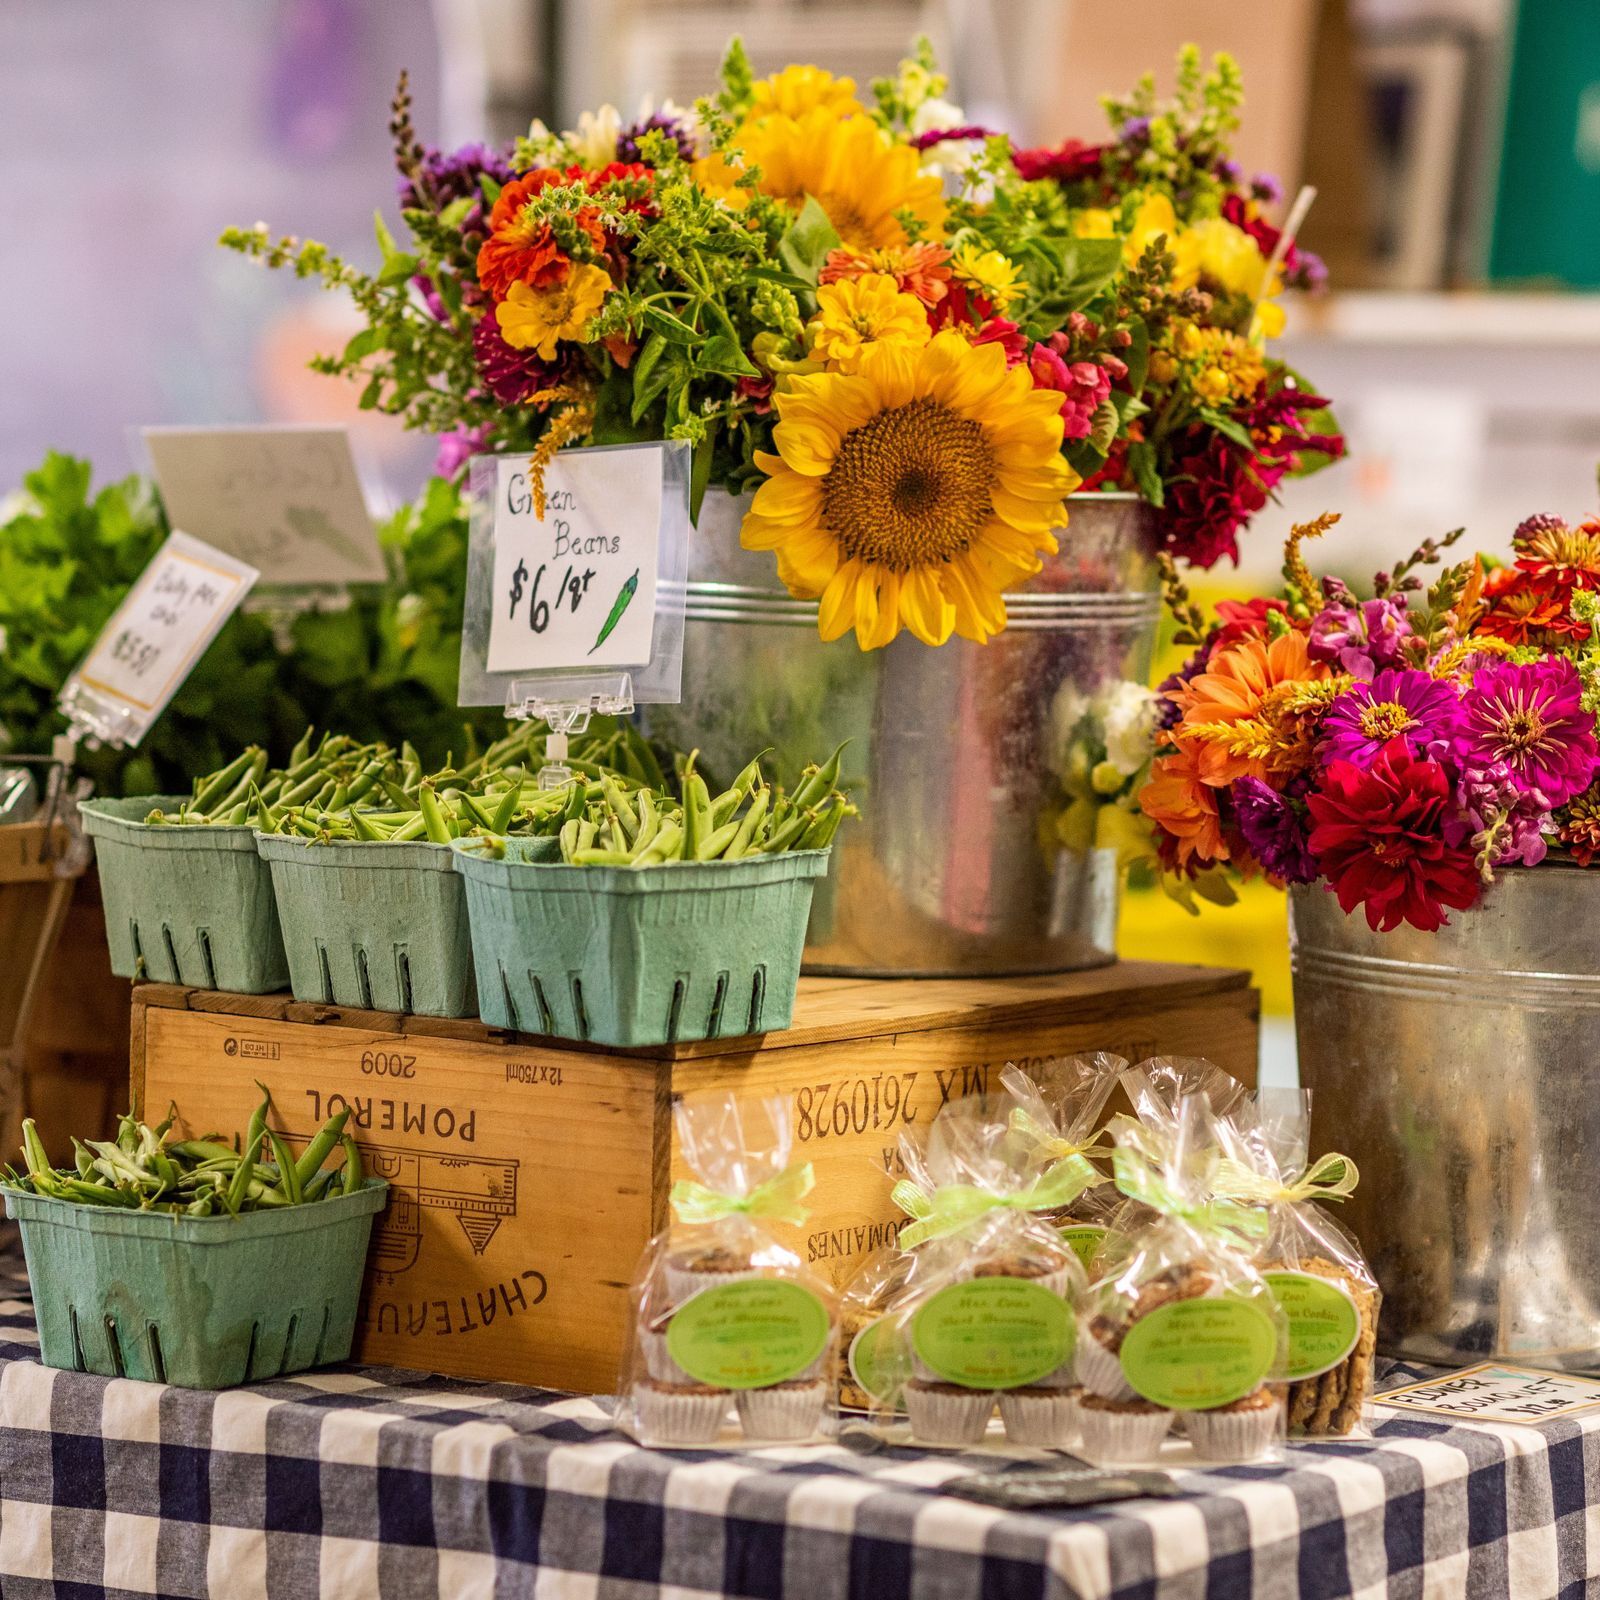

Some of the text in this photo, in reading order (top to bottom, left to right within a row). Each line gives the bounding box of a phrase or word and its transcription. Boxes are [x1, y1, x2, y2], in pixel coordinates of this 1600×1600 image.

[508, 473, 577, 515] Gren
[552, 519, 620, 560] Beans
[361, 1050, 417, 1079] 2009
[306, 1089, 476, 1142] POMEROL
[797, 1071, 918, 1142] 2610928
[377, 1270, 548, 1337] CHATEAU
[1389, 1378, 1500, 1405] FLOWER
[1435, 1378, 1575, 1413] BOUQUET
